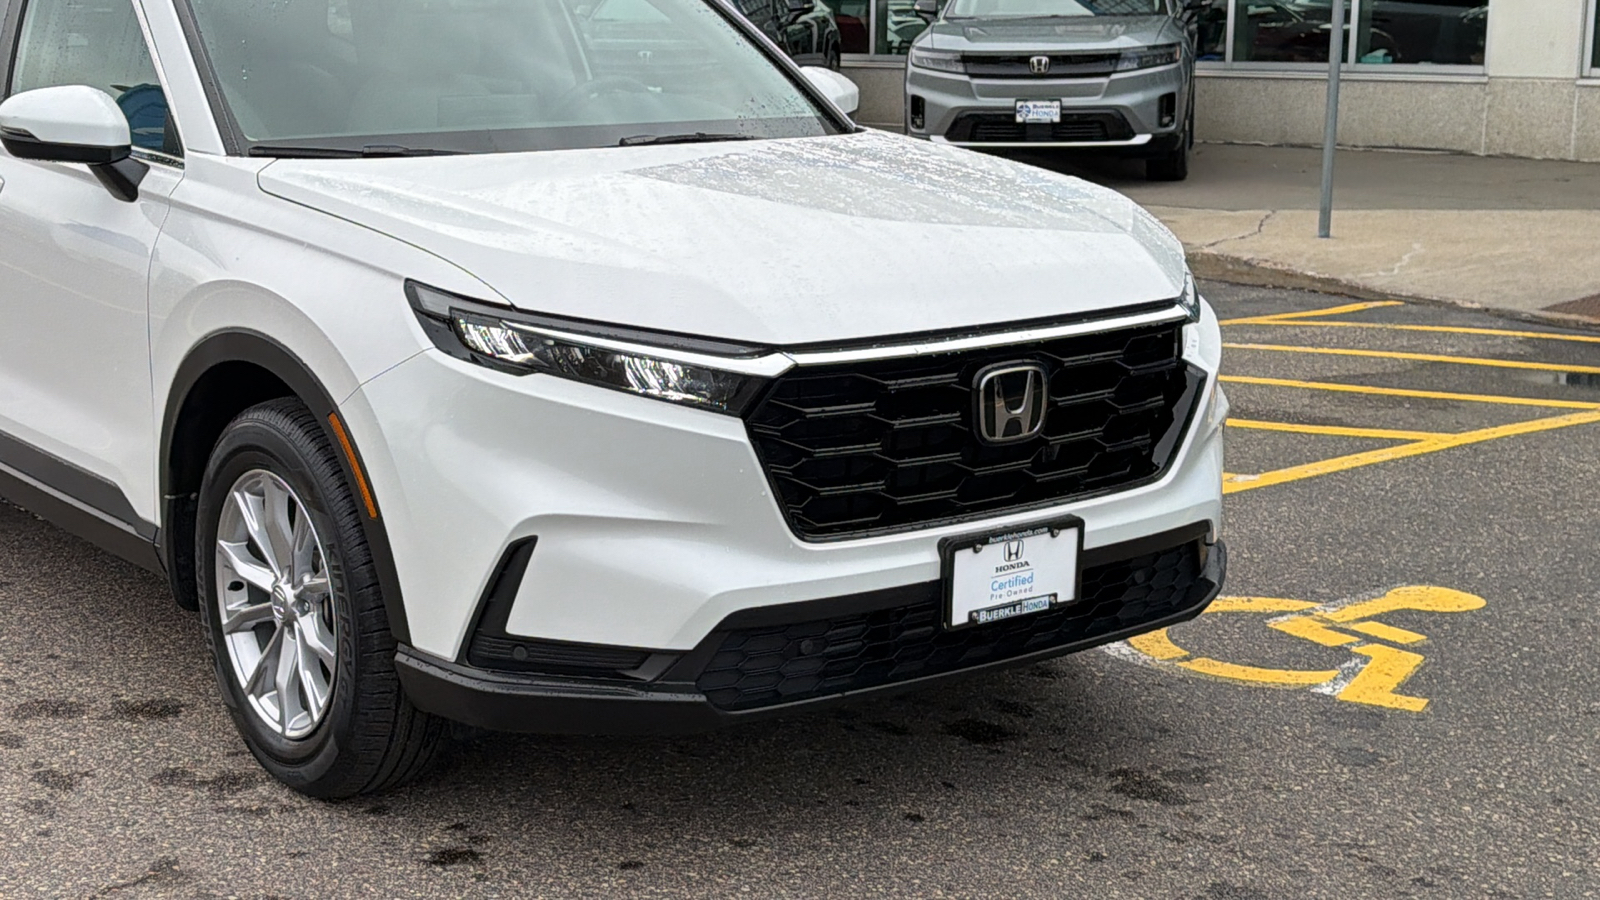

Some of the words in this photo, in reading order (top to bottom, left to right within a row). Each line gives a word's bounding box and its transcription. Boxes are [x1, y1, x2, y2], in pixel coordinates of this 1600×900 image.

[1032, 109, 1059, 117] HONDA
[995, 560, 1030, 573] HONDA
[991, 572, 1034, 592] Certified
[979, 604, 1022, 623] BUERKLE
[1022, 599, 1048, 612] HONDA
